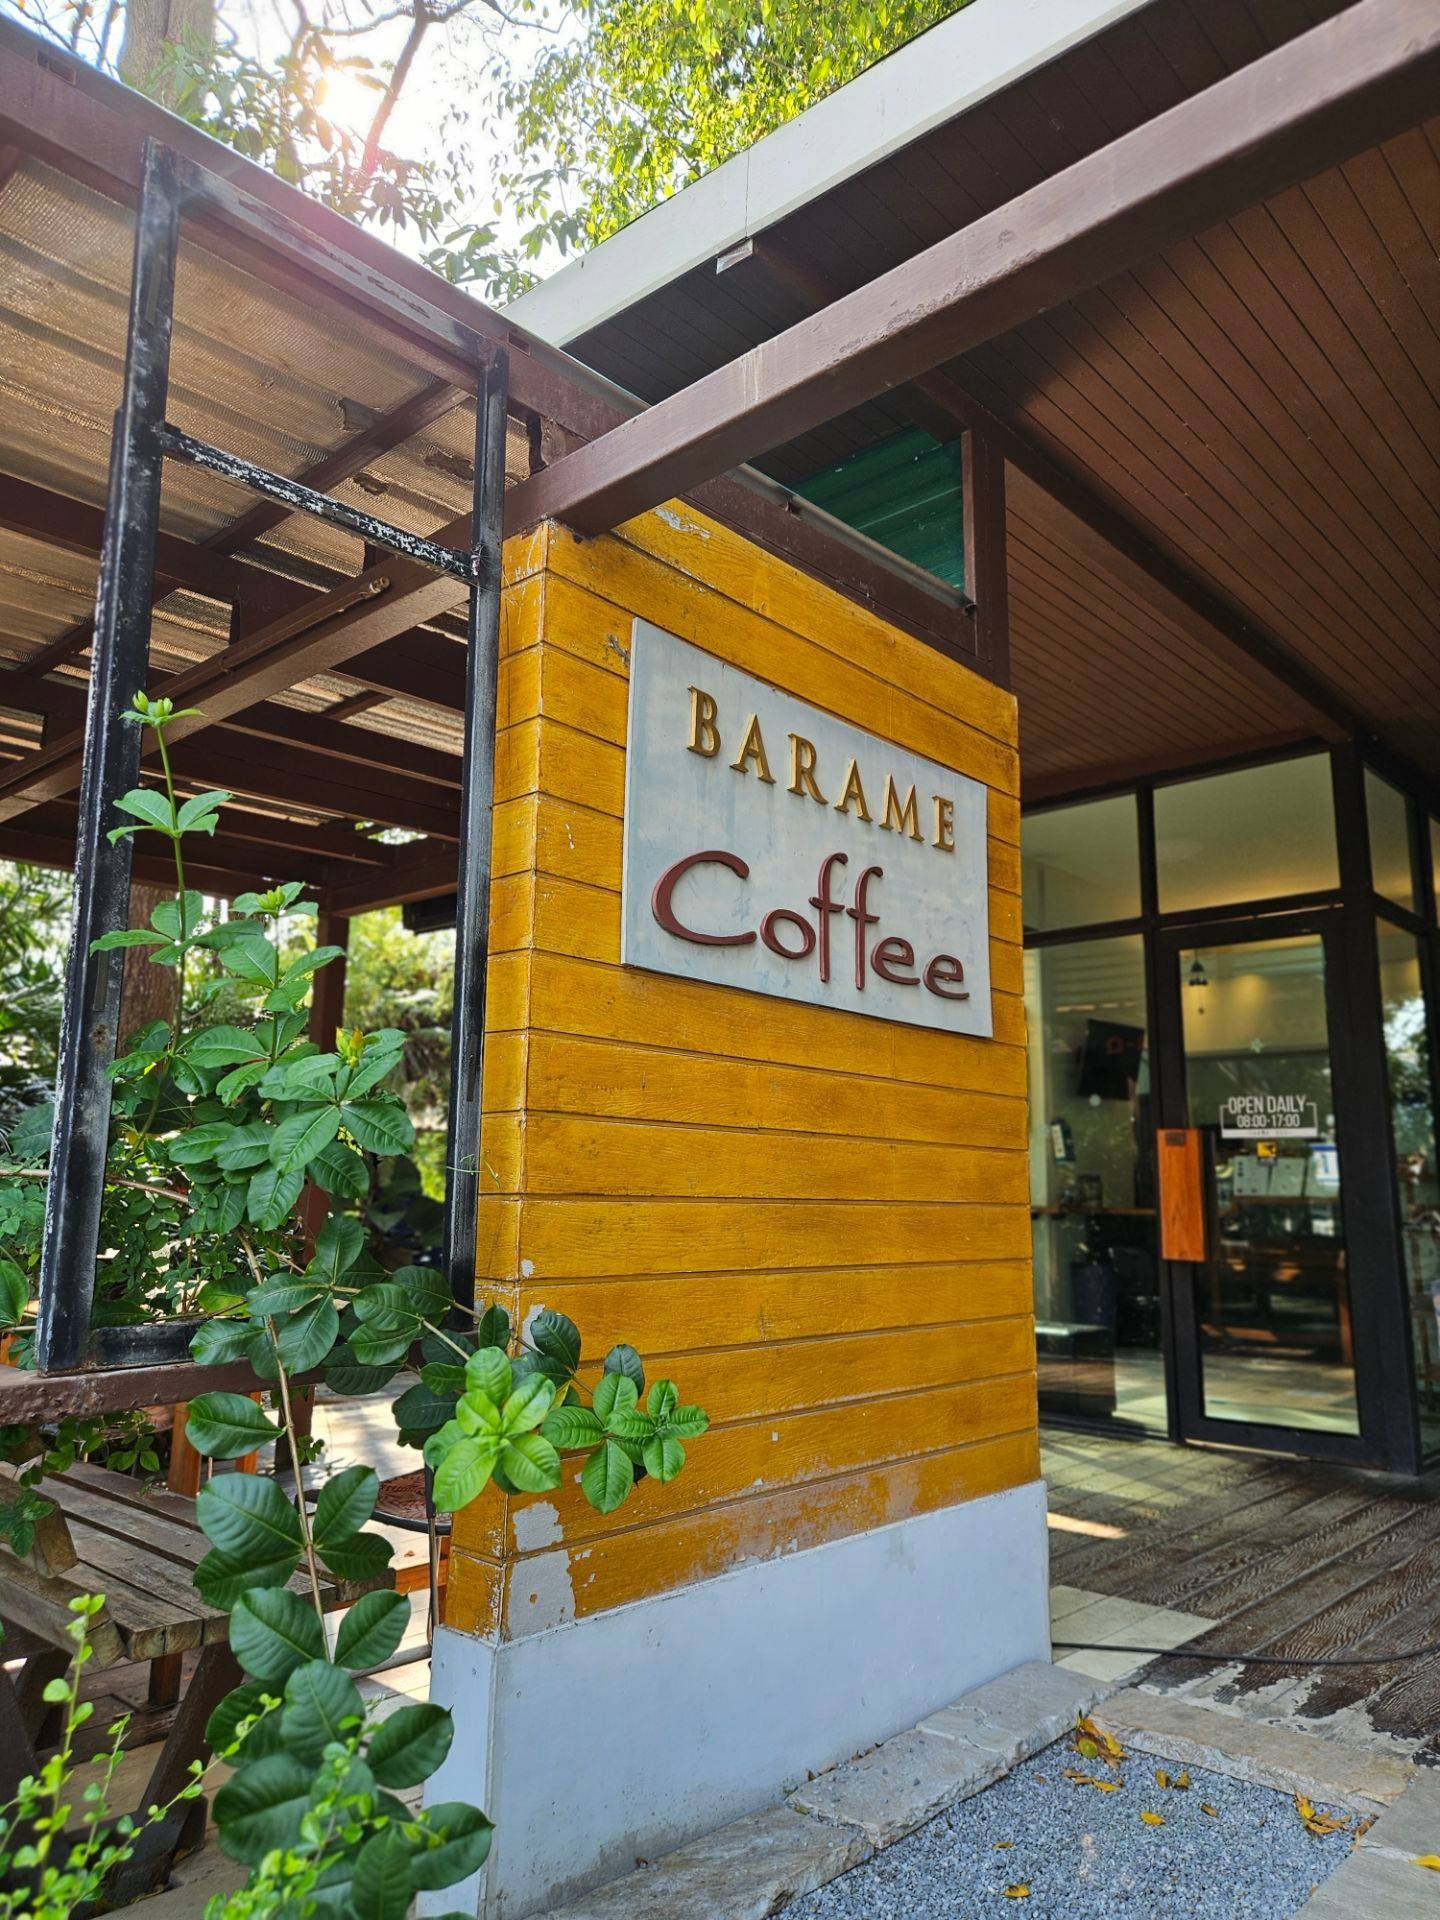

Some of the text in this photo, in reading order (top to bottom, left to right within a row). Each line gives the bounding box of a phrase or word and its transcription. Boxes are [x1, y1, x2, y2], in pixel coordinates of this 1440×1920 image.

[687, 685, 956, 852] BARAME
[652, 850, 970, 1000] Coffee
[1228, 1094, 1306, 1114] OPEN DAILY
